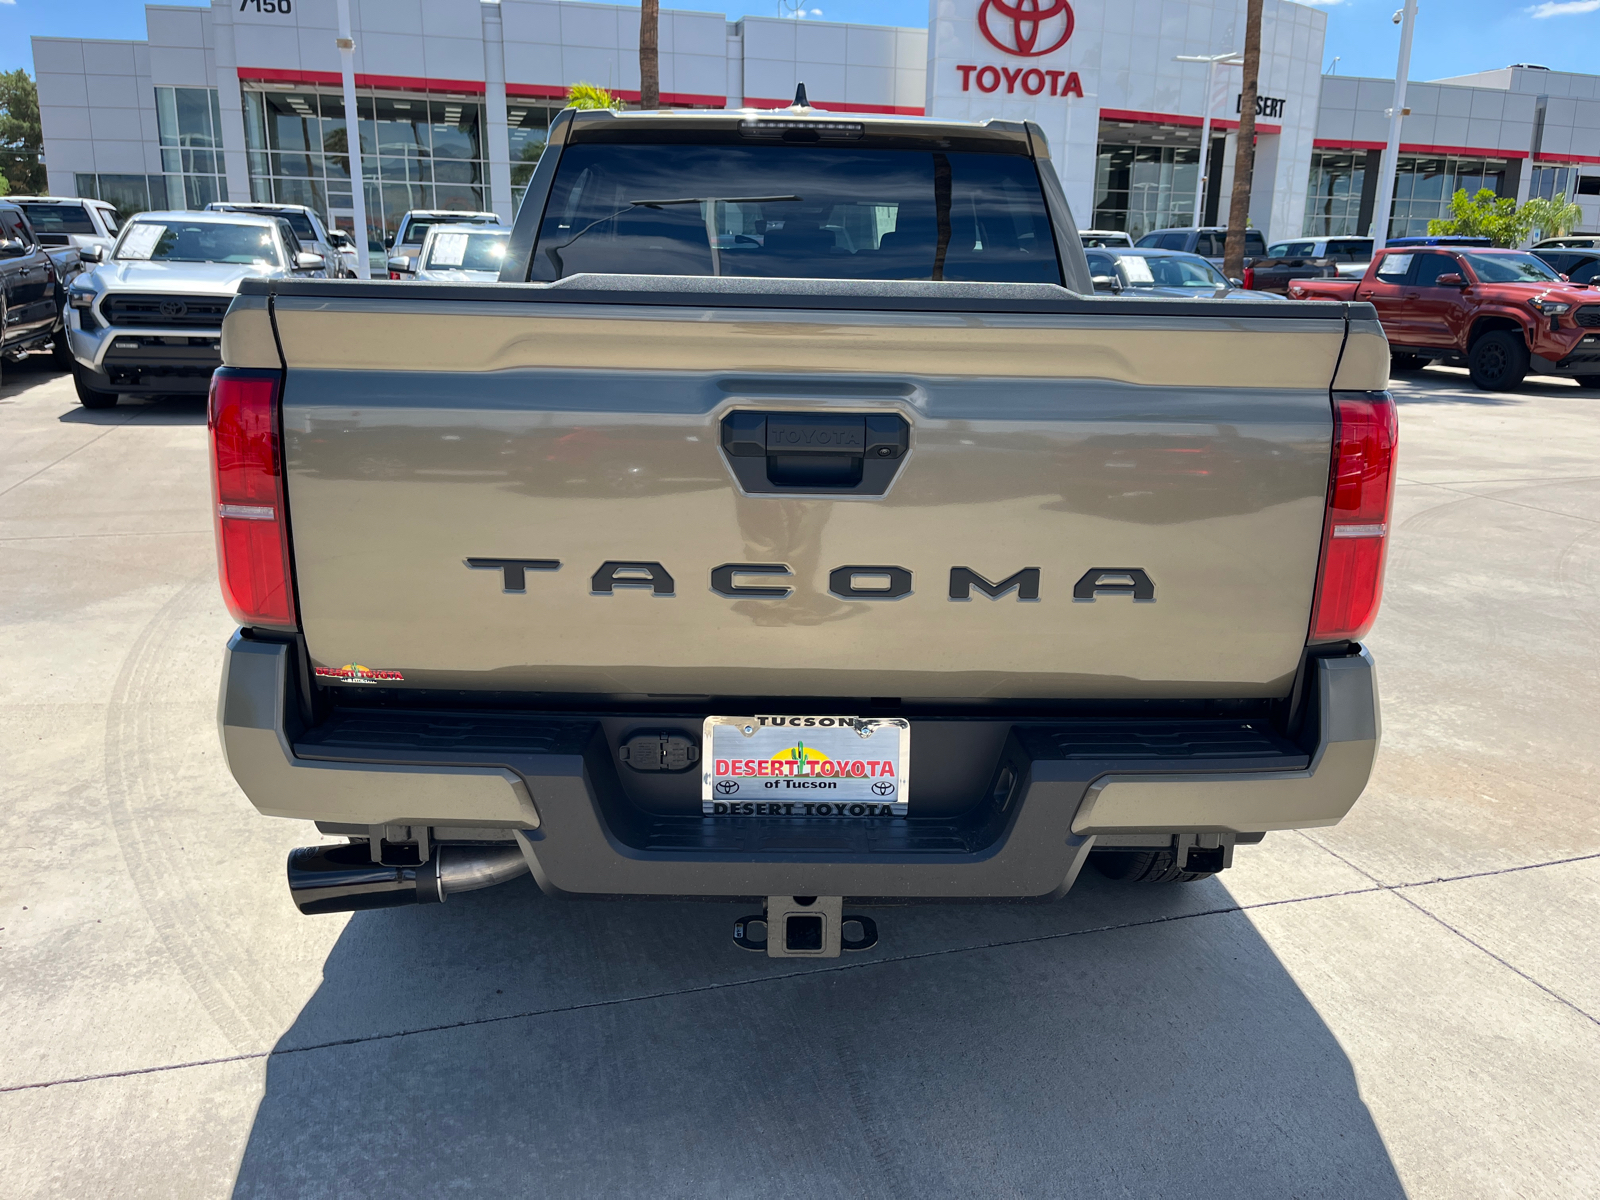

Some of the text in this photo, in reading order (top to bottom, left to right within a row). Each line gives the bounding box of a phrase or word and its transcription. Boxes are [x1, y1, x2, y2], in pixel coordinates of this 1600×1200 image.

[956, 65, 1084, 98] TOYOTA
[772, 429, 860, 445] TOYOTA
[465, 557, 1156, 602] TACOMA
[315, 667, 404, 680] DESERT TOYOTA
[757, 716, 855, 727] TUCSON
[715, 759, 895, 777] DESERT TOYOTA
[764, 779, 837, 789] of Tucson
[714, 802, 893, 817] DESERT TOYOTA
